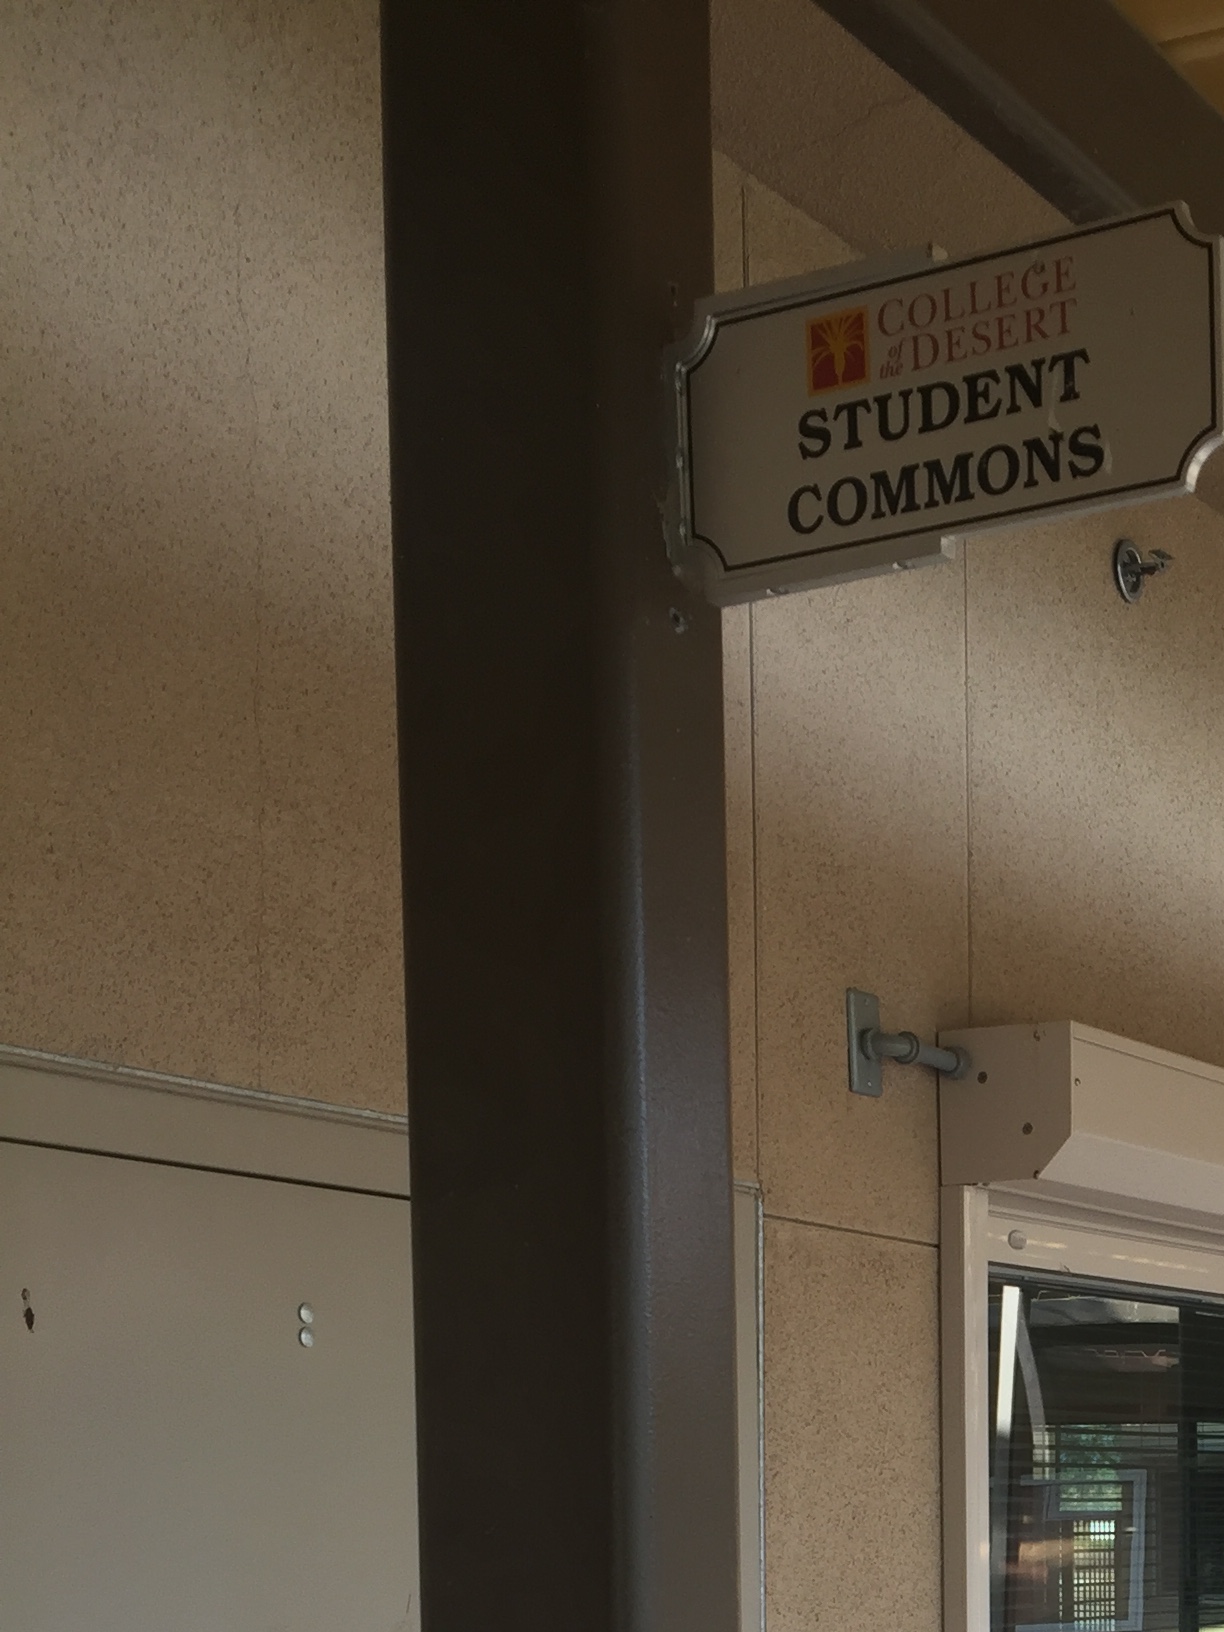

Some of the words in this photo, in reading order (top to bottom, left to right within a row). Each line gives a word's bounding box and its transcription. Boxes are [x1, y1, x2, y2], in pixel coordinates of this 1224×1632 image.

[878, 256, 1077, 337] COLLEGE
[911, 298, 1077, 371] DESERT
[879, 358, 904, 379] the
[888, 336, 906, 358] of
[798, 349, 1090, 460] STUDENT
[788, 424, 1104, 534] COMMONS
